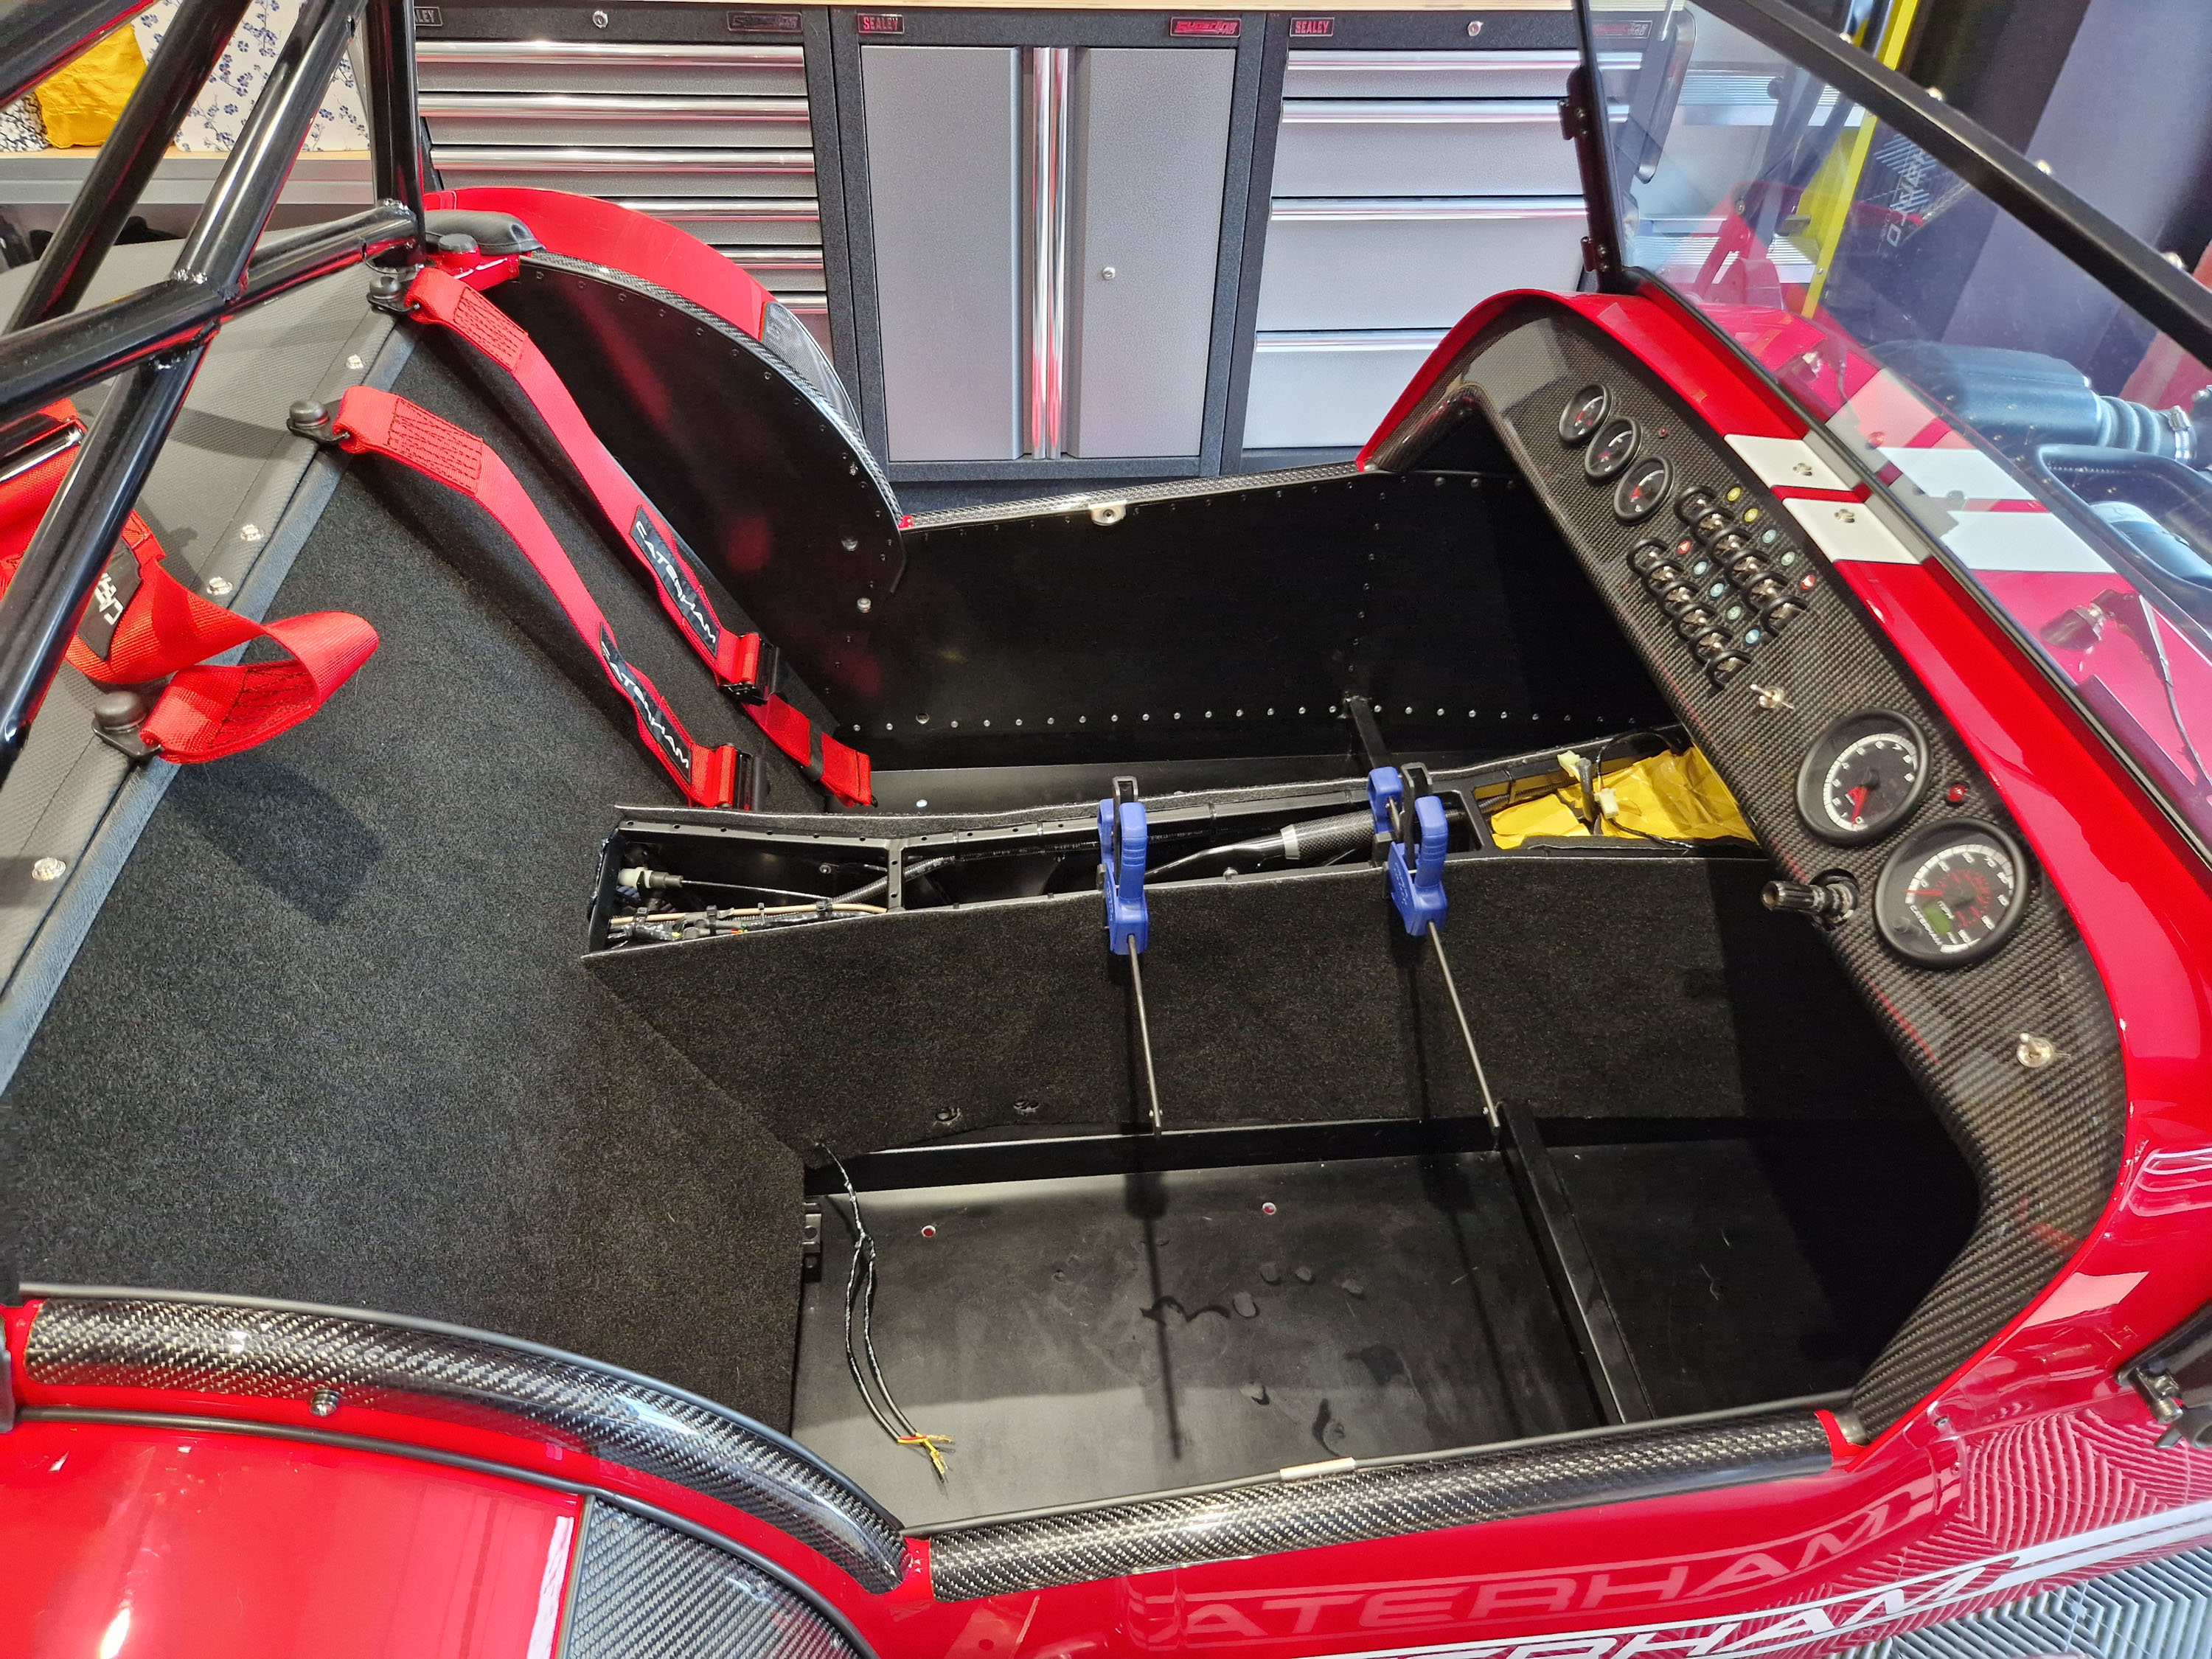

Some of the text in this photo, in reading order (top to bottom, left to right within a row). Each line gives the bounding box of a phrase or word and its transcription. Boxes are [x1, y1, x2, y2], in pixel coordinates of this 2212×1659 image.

[414, 10, 435, 23] LEY
[863, 17, 898, 31] SEALEY
[1295, 21, 1329, 34] SEALEY
[637, 521, 717, 644] CATERHAM
[1855, 815, 1864, 824] 0
[1910, 905, 1943, 945] CATERHAM
